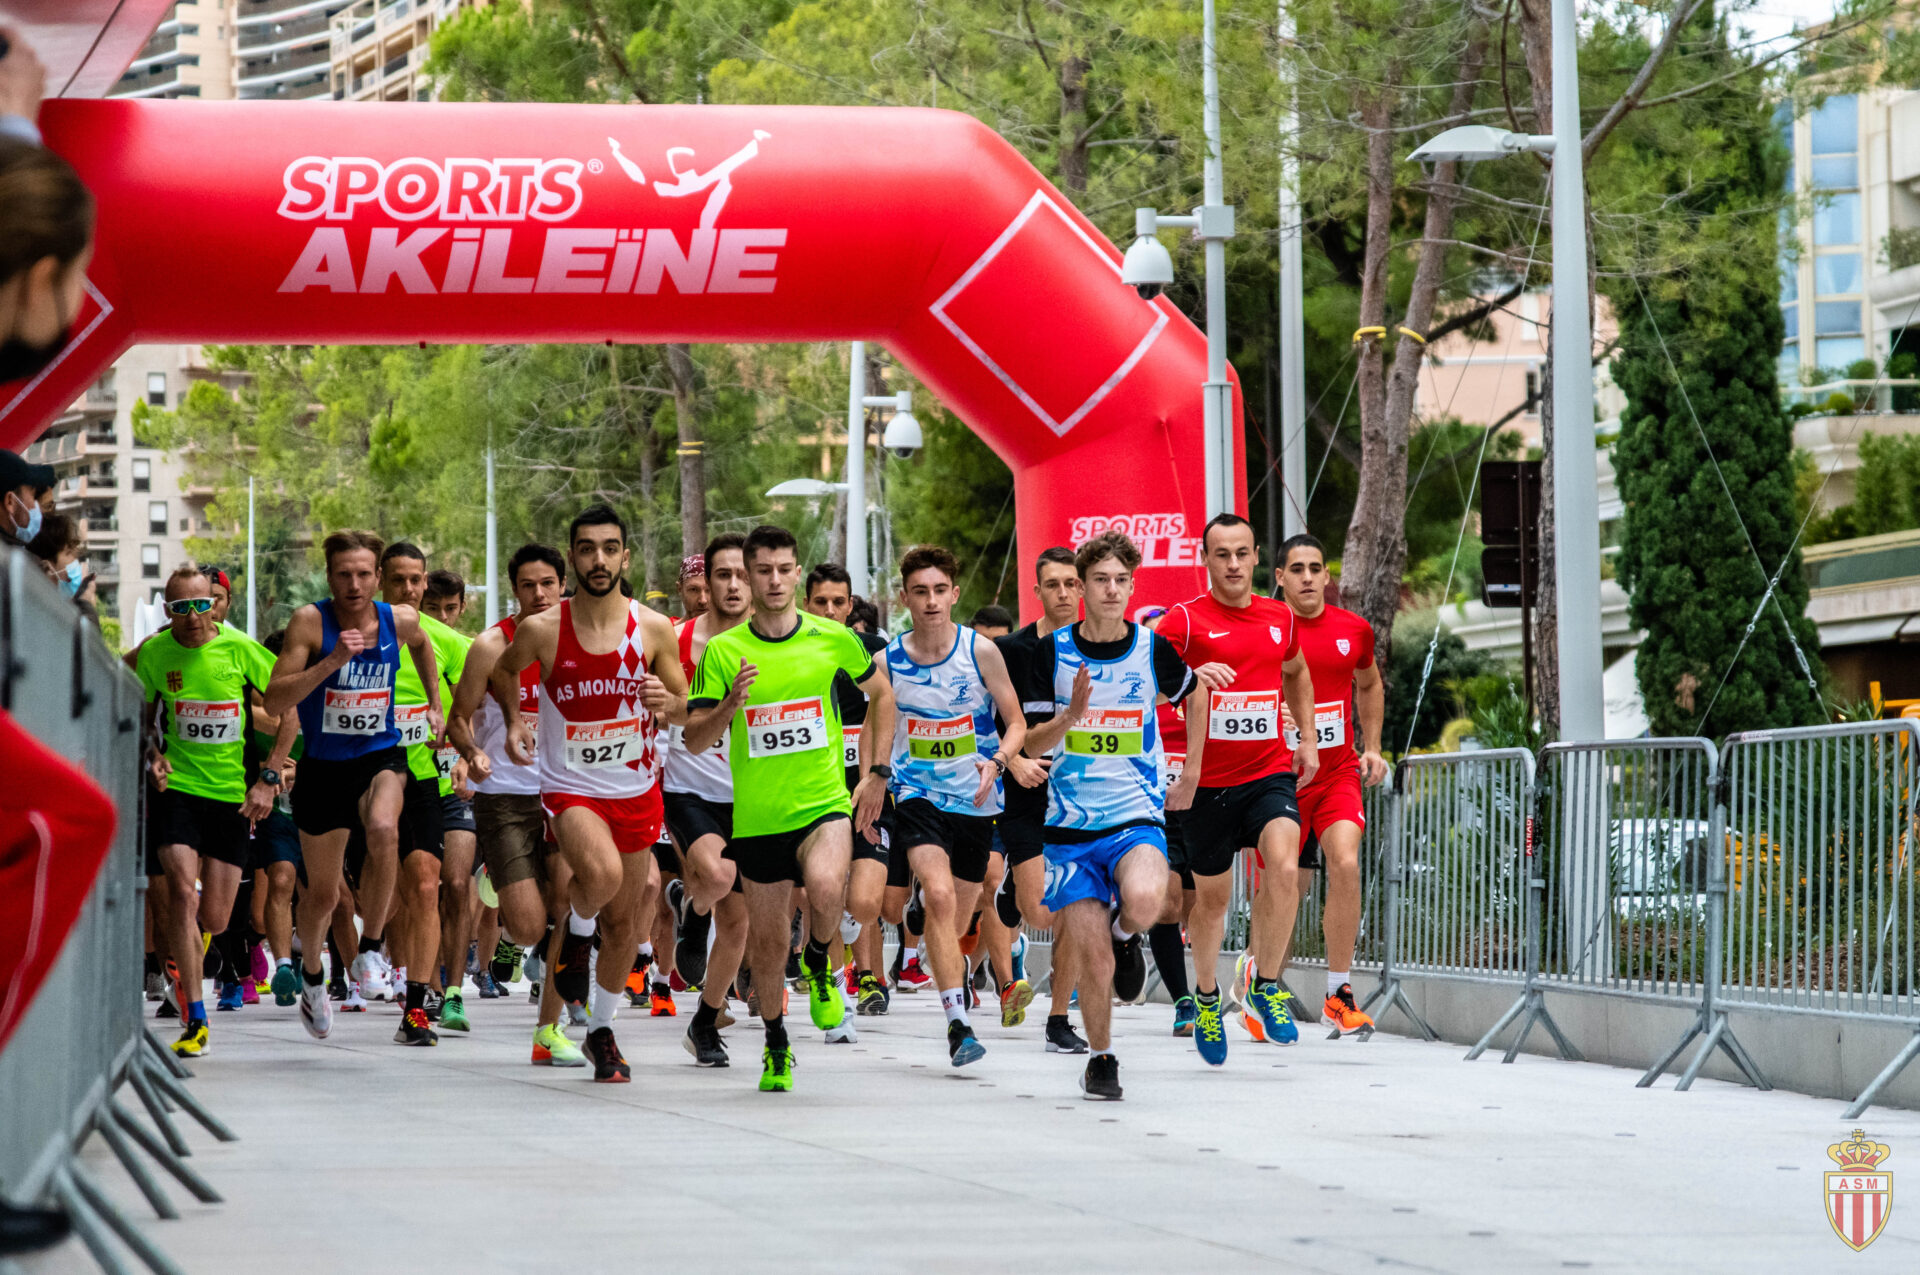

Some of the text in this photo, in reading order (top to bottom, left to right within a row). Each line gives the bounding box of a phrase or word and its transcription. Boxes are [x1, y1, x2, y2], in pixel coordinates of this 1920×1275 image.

[277, 156, 584, 222] SPORTS
[1070, 513, 1186, 544] SPORTS
[556, 684, 574, 703] AS
[187, 723, 228, 738] 967
[338, 714, 380, 730] 962
[1225, 718, 1267, 734] 936
[398, 726, 421, 741] 16
[762, 728, 812, 750] 953
[581, 742, 626, 763] 927
[930, 742, 956, 758] 40
[1090, 735, 1119, 753] 39
